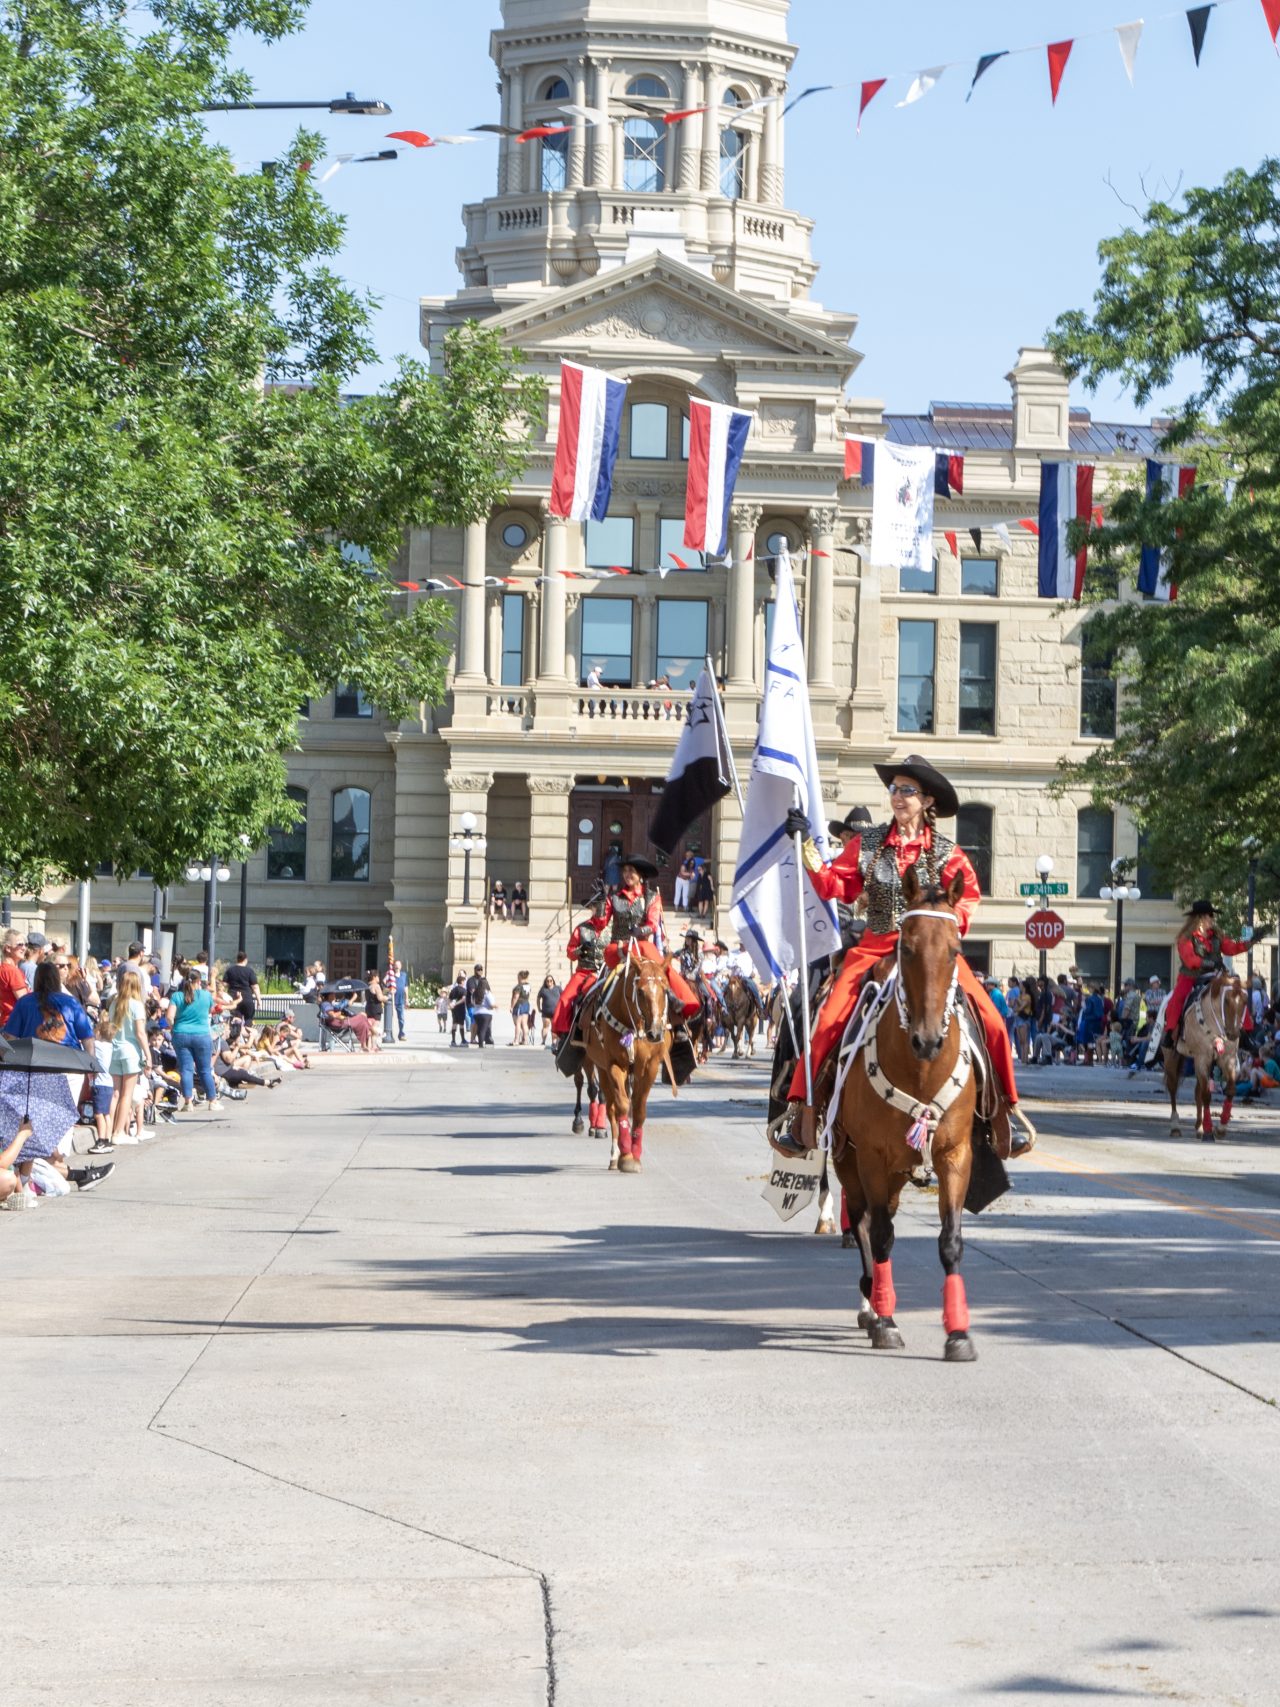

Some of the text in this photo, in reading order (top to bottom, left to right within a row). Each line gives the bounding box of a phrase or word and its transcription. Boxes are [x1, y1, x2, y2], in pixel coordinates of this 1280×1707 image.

[1023, 884, 1066, 894] W 24th St
[1028, 922, 1062, 938] STOP
[770, 1169, 820, 1191] CHEYENNE
[782, 1192, 799, 1210] WY
